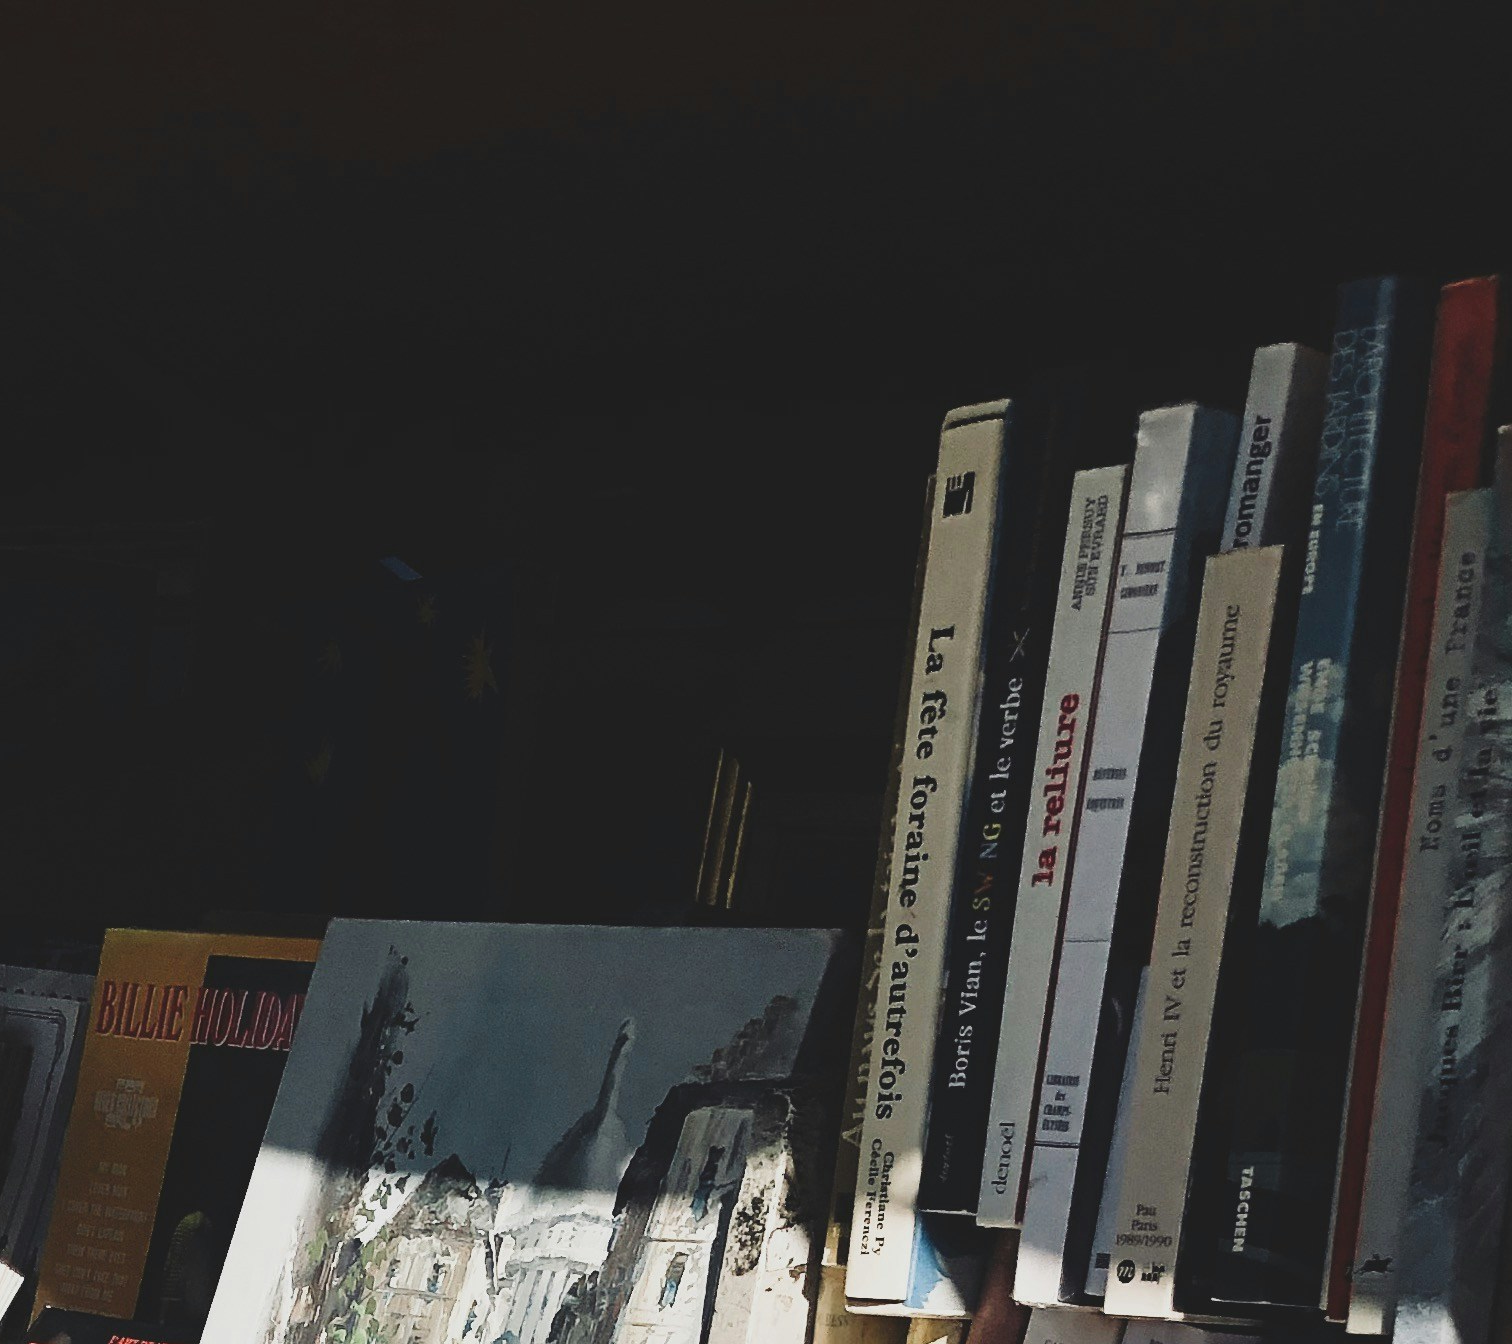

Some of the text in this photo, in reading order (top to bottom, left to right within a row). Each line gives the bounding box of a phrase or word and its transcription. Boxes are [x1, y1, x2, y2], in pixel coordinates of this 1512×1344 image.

[1232, 414, 1272, 549] romanger
[999, 676, 1023, 745] verbe
[999, 745, 1011, 780] le
[1031, 693, 1082, 888] la reliure
[990, 788, 1007, 813] et
[875, 625, 955, 1121] La fête foraine d'autrefois
[1153, 603, 1241, 1096] Henri et la reconstruction du royaume
[967, 918, 988, 945] le
[95, 980, 187, 1042] BILLIE
[947, 1030, 974, 1089] Boris
[1130, 1219, 1158, 1232] Paris
[1135, 1203, 1157, 1217] Pau
[1231, 1166, 1256, 1254] TASCHEN
[1116, 1233, 1173, 1248] 1989/1990
